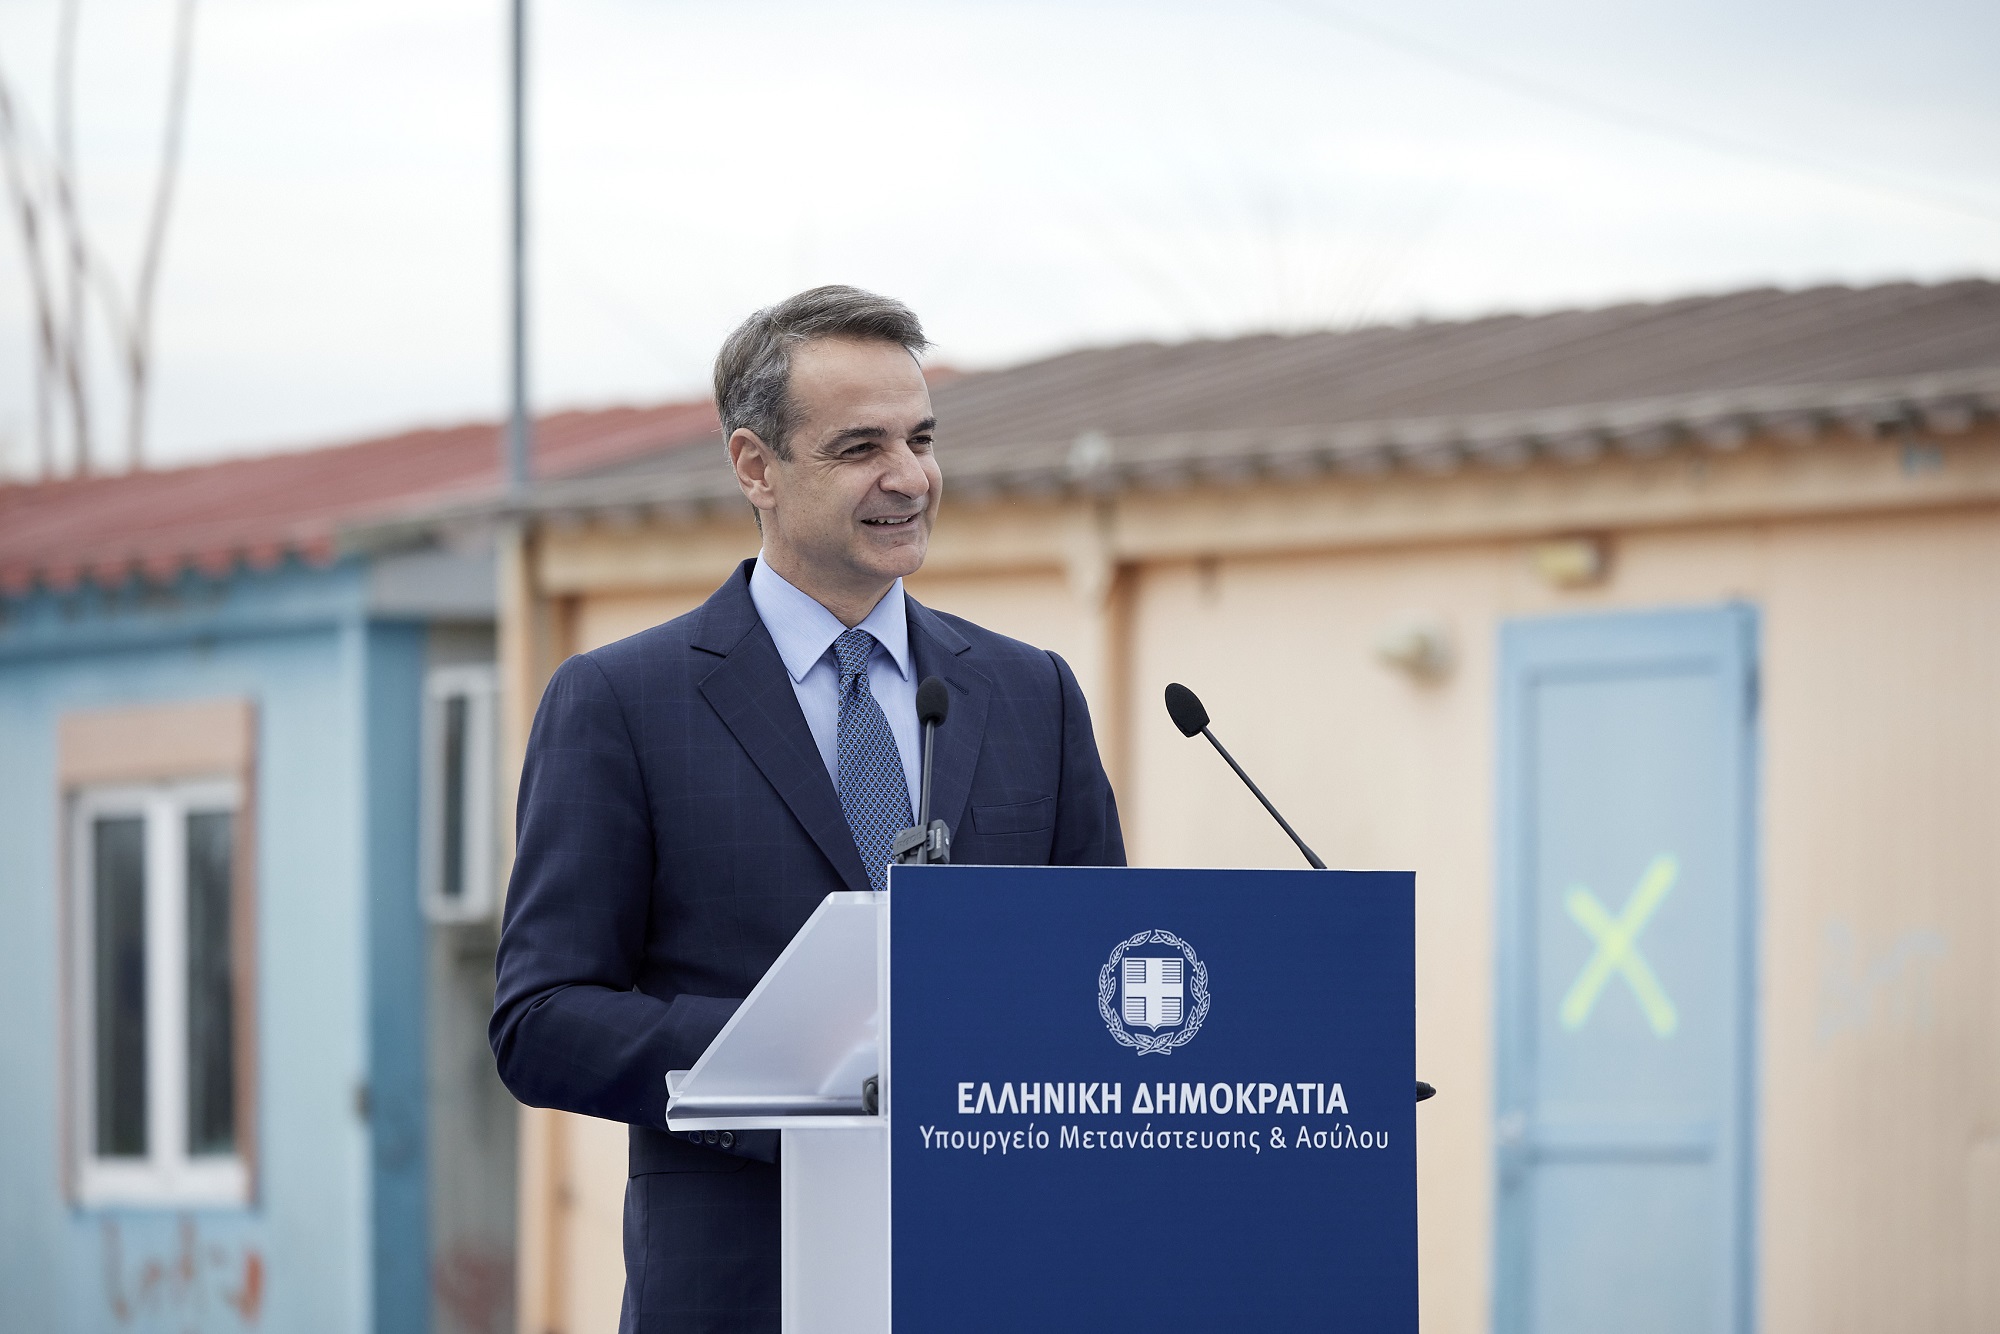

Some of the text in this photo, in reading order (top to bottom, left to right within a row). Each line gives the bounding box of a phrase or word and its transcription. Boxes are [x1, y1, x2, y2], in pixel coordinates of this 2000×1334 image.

[957, 1082, 1349, 1115] ΕΛΛΗΝΙΚΗ ΔΗΜΟΚΡΑΤΙΑ
[919, 1122, 1389, 1155] Υπουργείο Μετανάστευσης & Ασύλου
